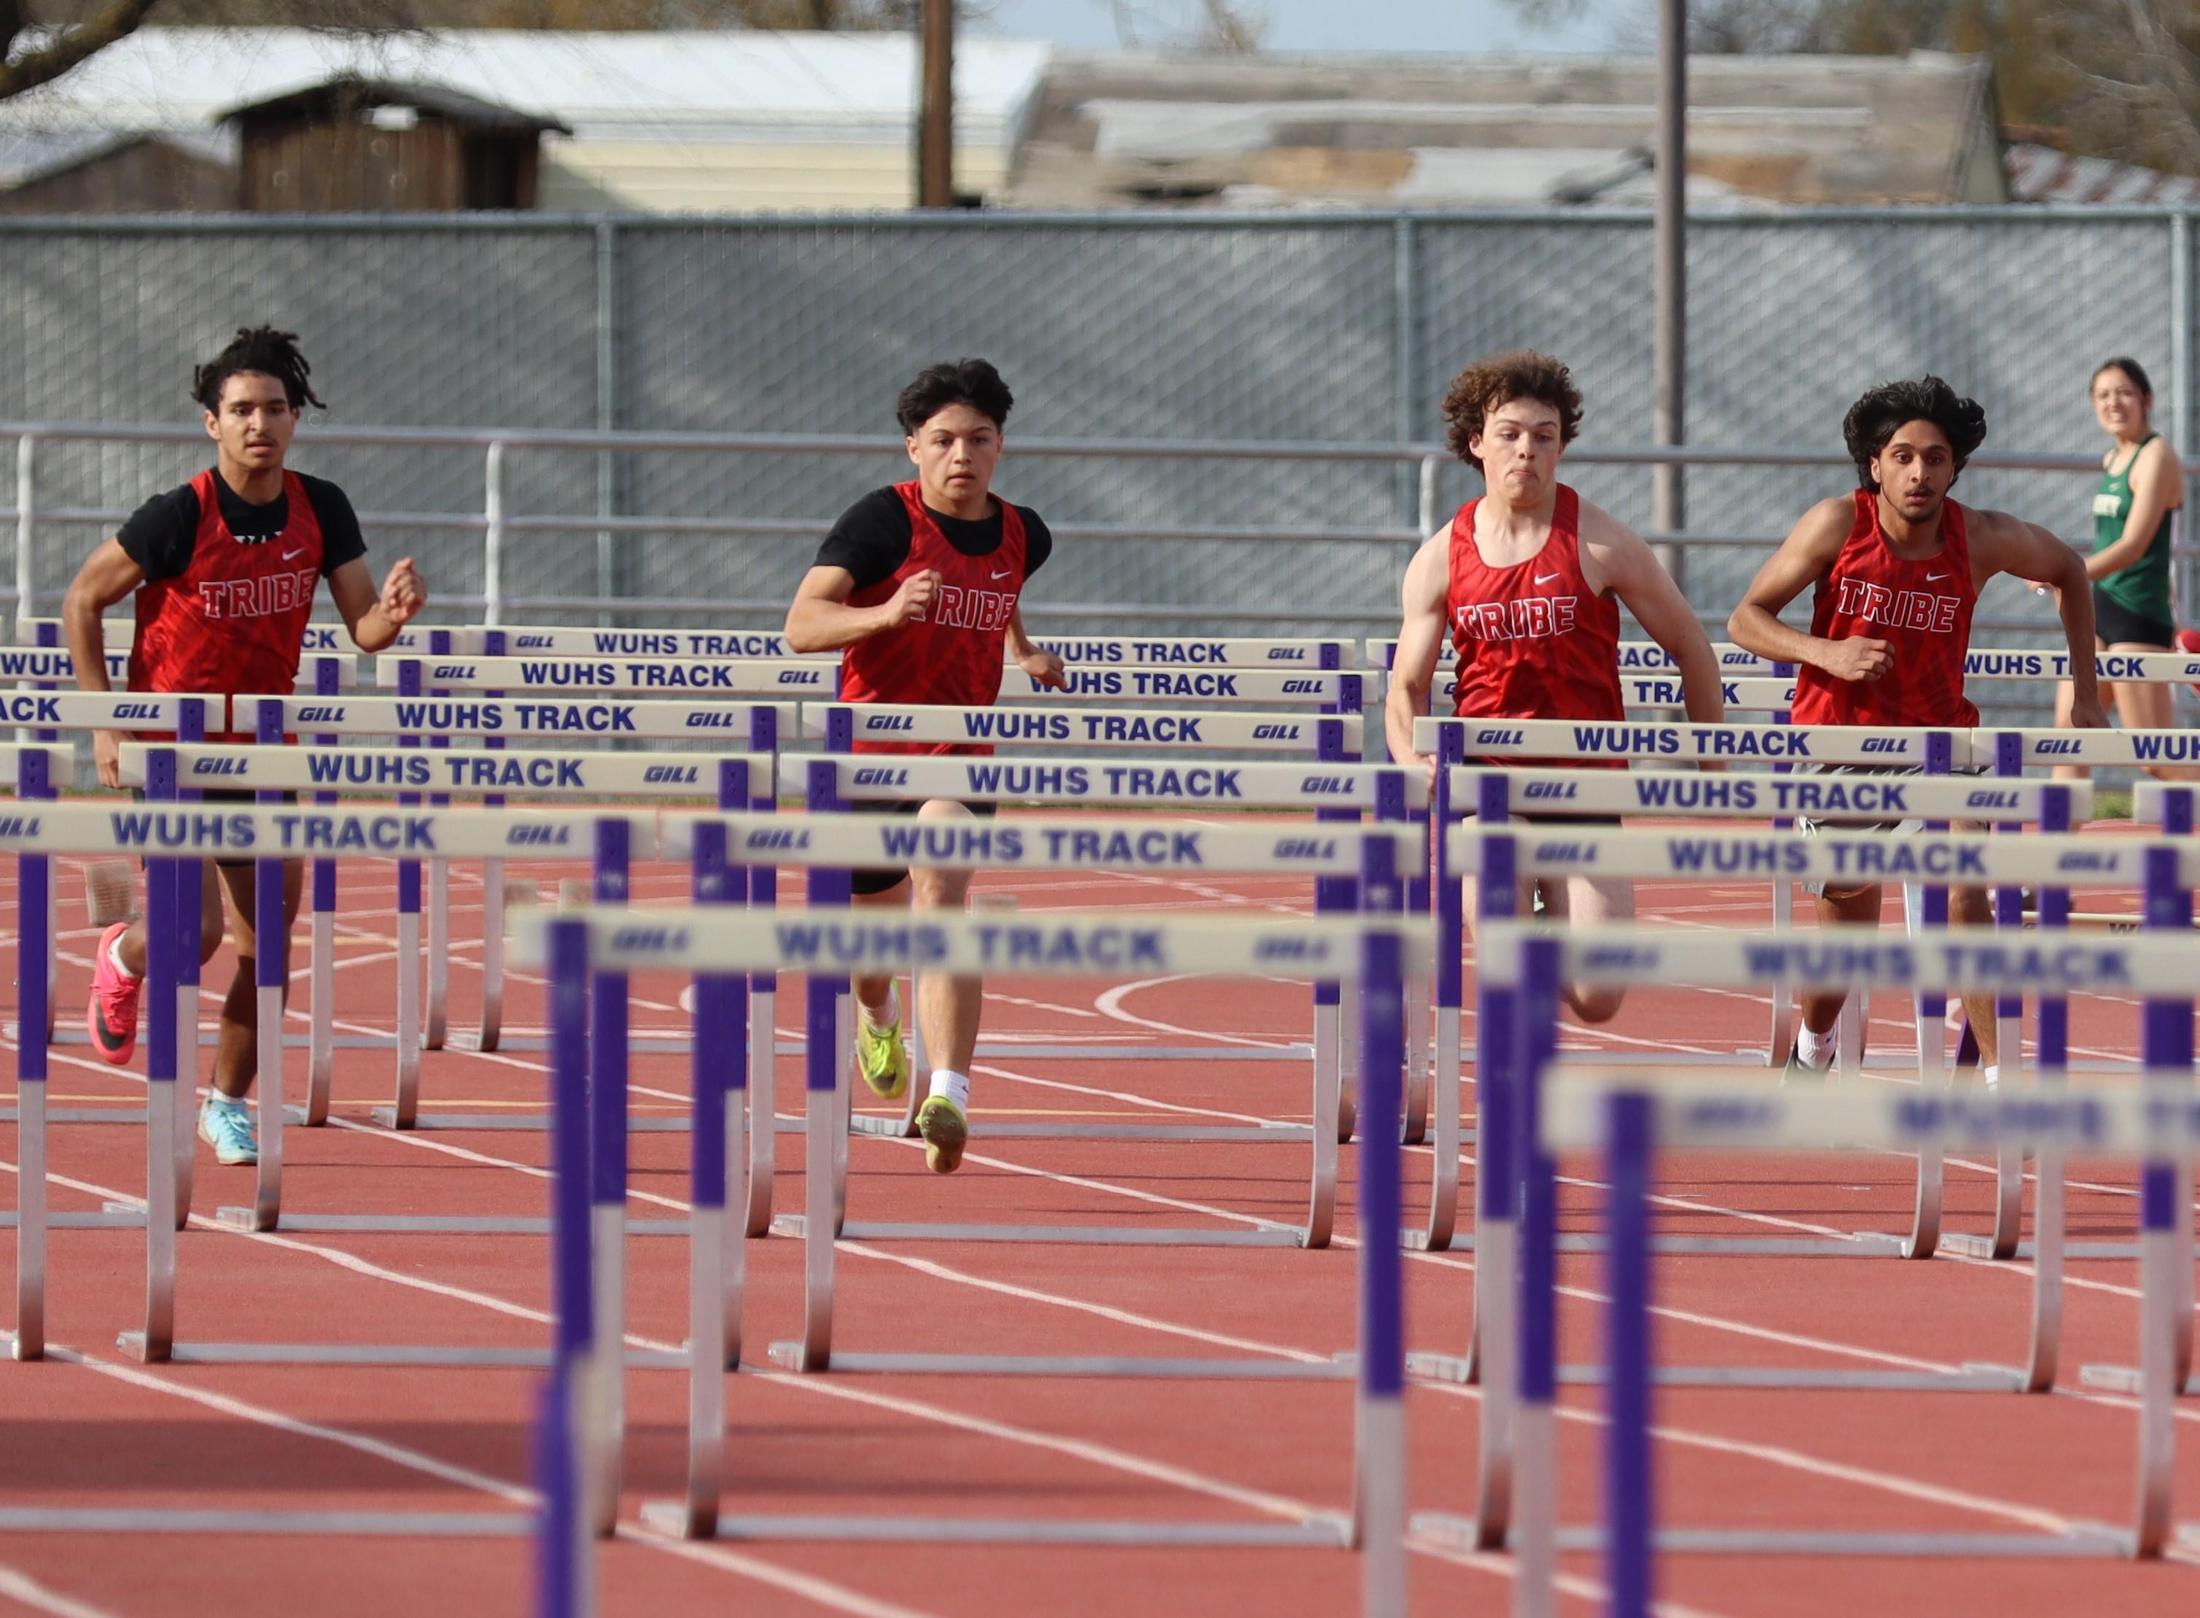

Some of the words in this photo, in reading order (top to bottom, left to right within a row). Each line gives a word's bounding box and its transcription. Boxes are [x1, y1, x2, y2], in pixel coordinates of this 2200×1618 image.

[199, 567, 317, 618] TRIBE
[1839, 577, 1960, 633] TRIBE
[910, 585, 1017, 631] RIBE
[1457, 596, 1577, 641] TRIBE
[396, 635, 415, 646] LL
[515, 636, 553, 648] GILL
[594, 634, 678, 654] WUHS
[688, 636, 783, 656] TRACK
[1132, 643, 1227, 663] TRACK
[1268, 648, 1304, 659] GILL
[0, 653, 74, 675] WUH
[1722, 653, 1758, 664] GILL
[1965, 655, 2041, 675] WUHS
[433, 666, 475, 679] GILL
[522, 664, 615, 686] WUHS
[626, 665, 733, 687] TRACK
[778, 671, 819, 683] GILL
[1136, 673, 1237, 696] TRACK
[1282, 681, 1322, 693] GILL
[113, 704, 159, 718] GILL
[297, 708, 344, 721] GILL
[396, 704, 502, 729] WUHS
[515, 705, 635, 731] TRACK
[686, 713, 732, 727] GILL
[866, 716, 913, 730] GILL
[964, 713, 1069, 739] WUHS
[1082, 716, 1202, 742] TRACK
[1253, 725, 1299, 739] GILL
[1476, 730, 1523, 744] GILL
[1574, 727, 1679, 753] WUHS
[1692, 730, 1810, 756] TRACK
[1861, 738, 1907, 752] GILL
[2035, 740, 2081, 754] GILL
[192, 758, 247, 775] GILL
[308, 755, 430, 785] WUHS
[445, 757, 584, 787] TRACK
[644, 767, 697, 783] GILL
[853, 769, 907, 785] GILL
[967, 766, 1088, 795] WUHS
[1104, 768, 1241, 797] TRACK
[1301, 777, 1353, 793] GILL
[1523, 782, 1576, 799] GILL
[1636, 779, 1756, 809] WUHS
[1772, 782, 1907, 811] TRACK
[1967, 791, 2018, 808] GILL
[0, 816, 41, 837] ILL
[112, 814, 255, 848] WUHS
[273, 816, 436, 851] TRACK
[507, 826, 568, 844] GILL
[745, 831, 808, 852] GILL
[882, 828, 1023, 861] WUHS
[1043, 830, 1202, 864] TRACK
[1274, 840, 1335, 859] GILL
[1669, 841, 1809, 874] WUHS
[1830, 842, 1986, 877] TRACK
[778, 926, 947, 967] WUHS
[977, 926, 1165, 971] TRACK
[1943, 946, 2130, 988] TRACK
